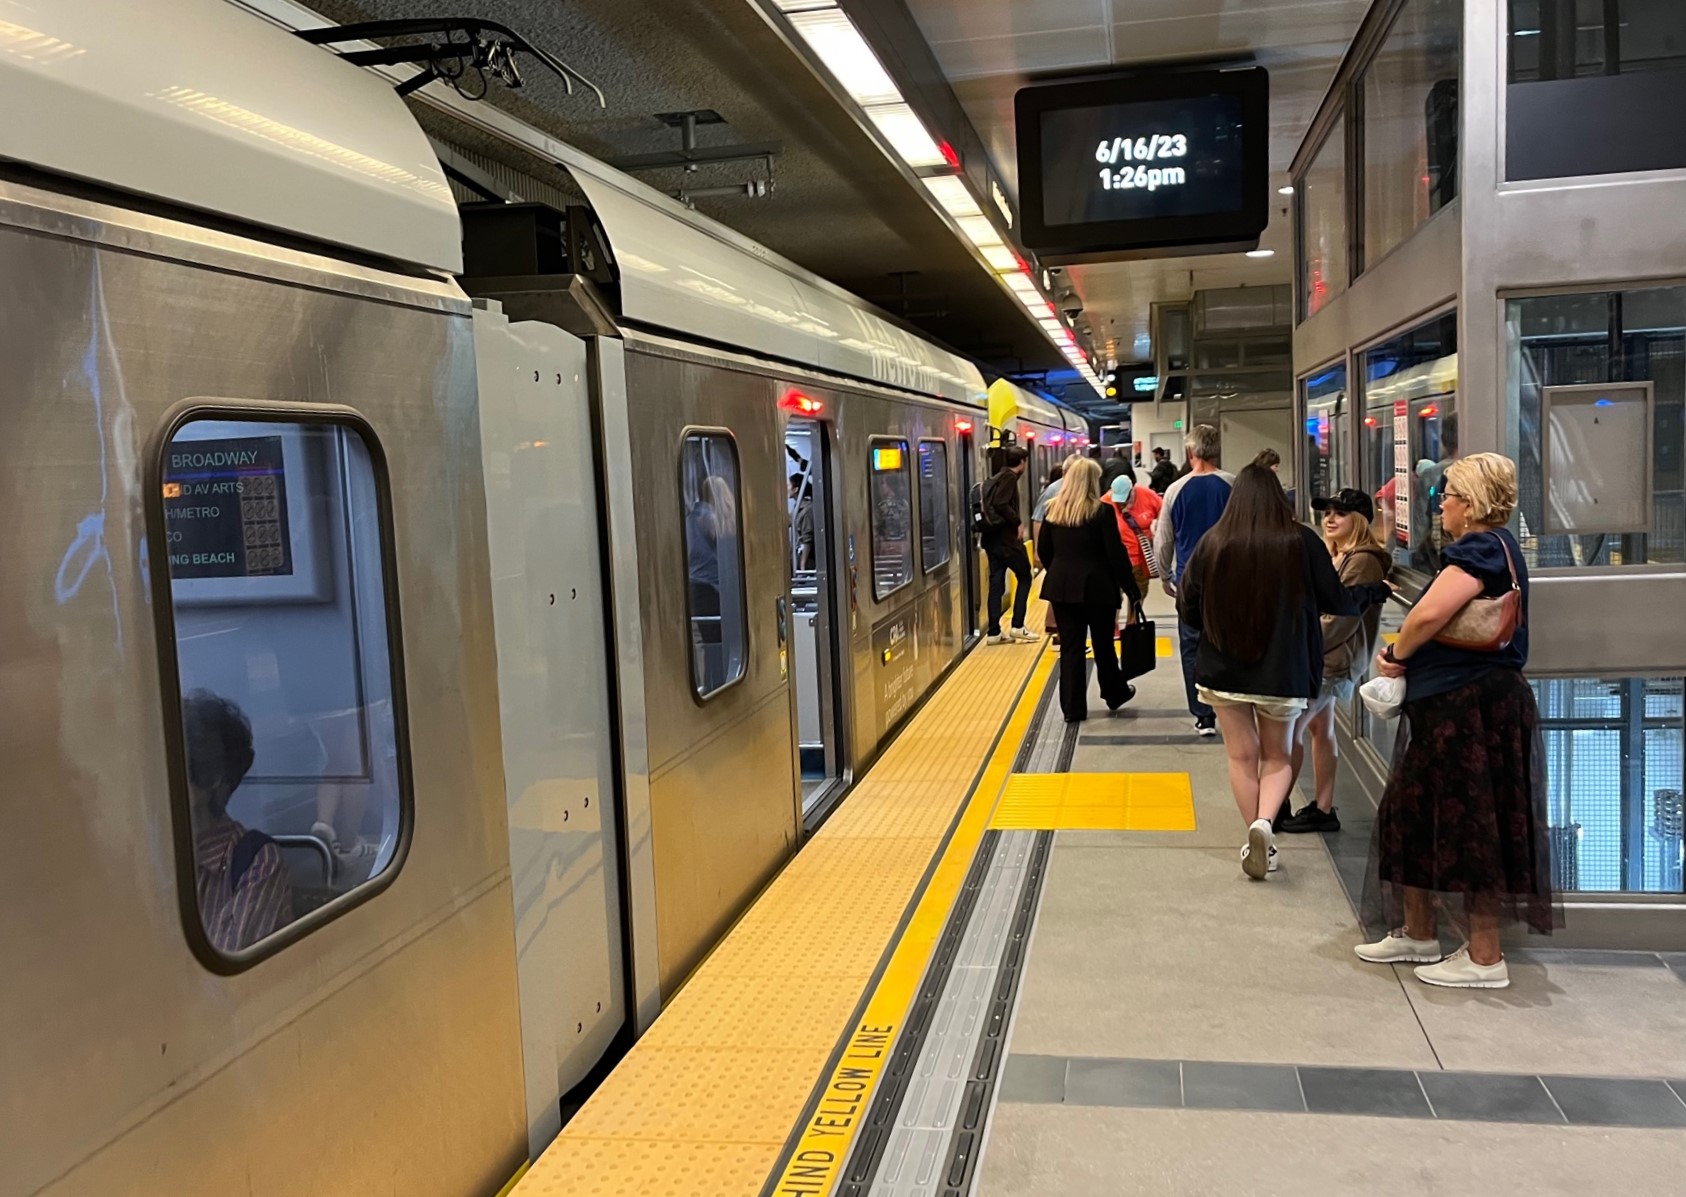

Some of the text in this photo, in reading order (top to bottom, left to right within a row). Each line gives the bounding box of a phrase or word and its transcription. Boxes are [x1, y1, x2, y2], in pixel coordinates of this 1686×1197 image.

[1095, 133, 1187, 163] 6/16/23
[1099, 165, 1185, 191] 1:26pm
[171, 450, 258, 468] BROADWAY
[195, 483, 209, 495] AV
[212, 481, 244, 494] ARTS
[193, 552, 235, 564] BEACH
[808, 1067, 873, 1138] YELLOW
[847, 1024, 893, 1058] LINE
